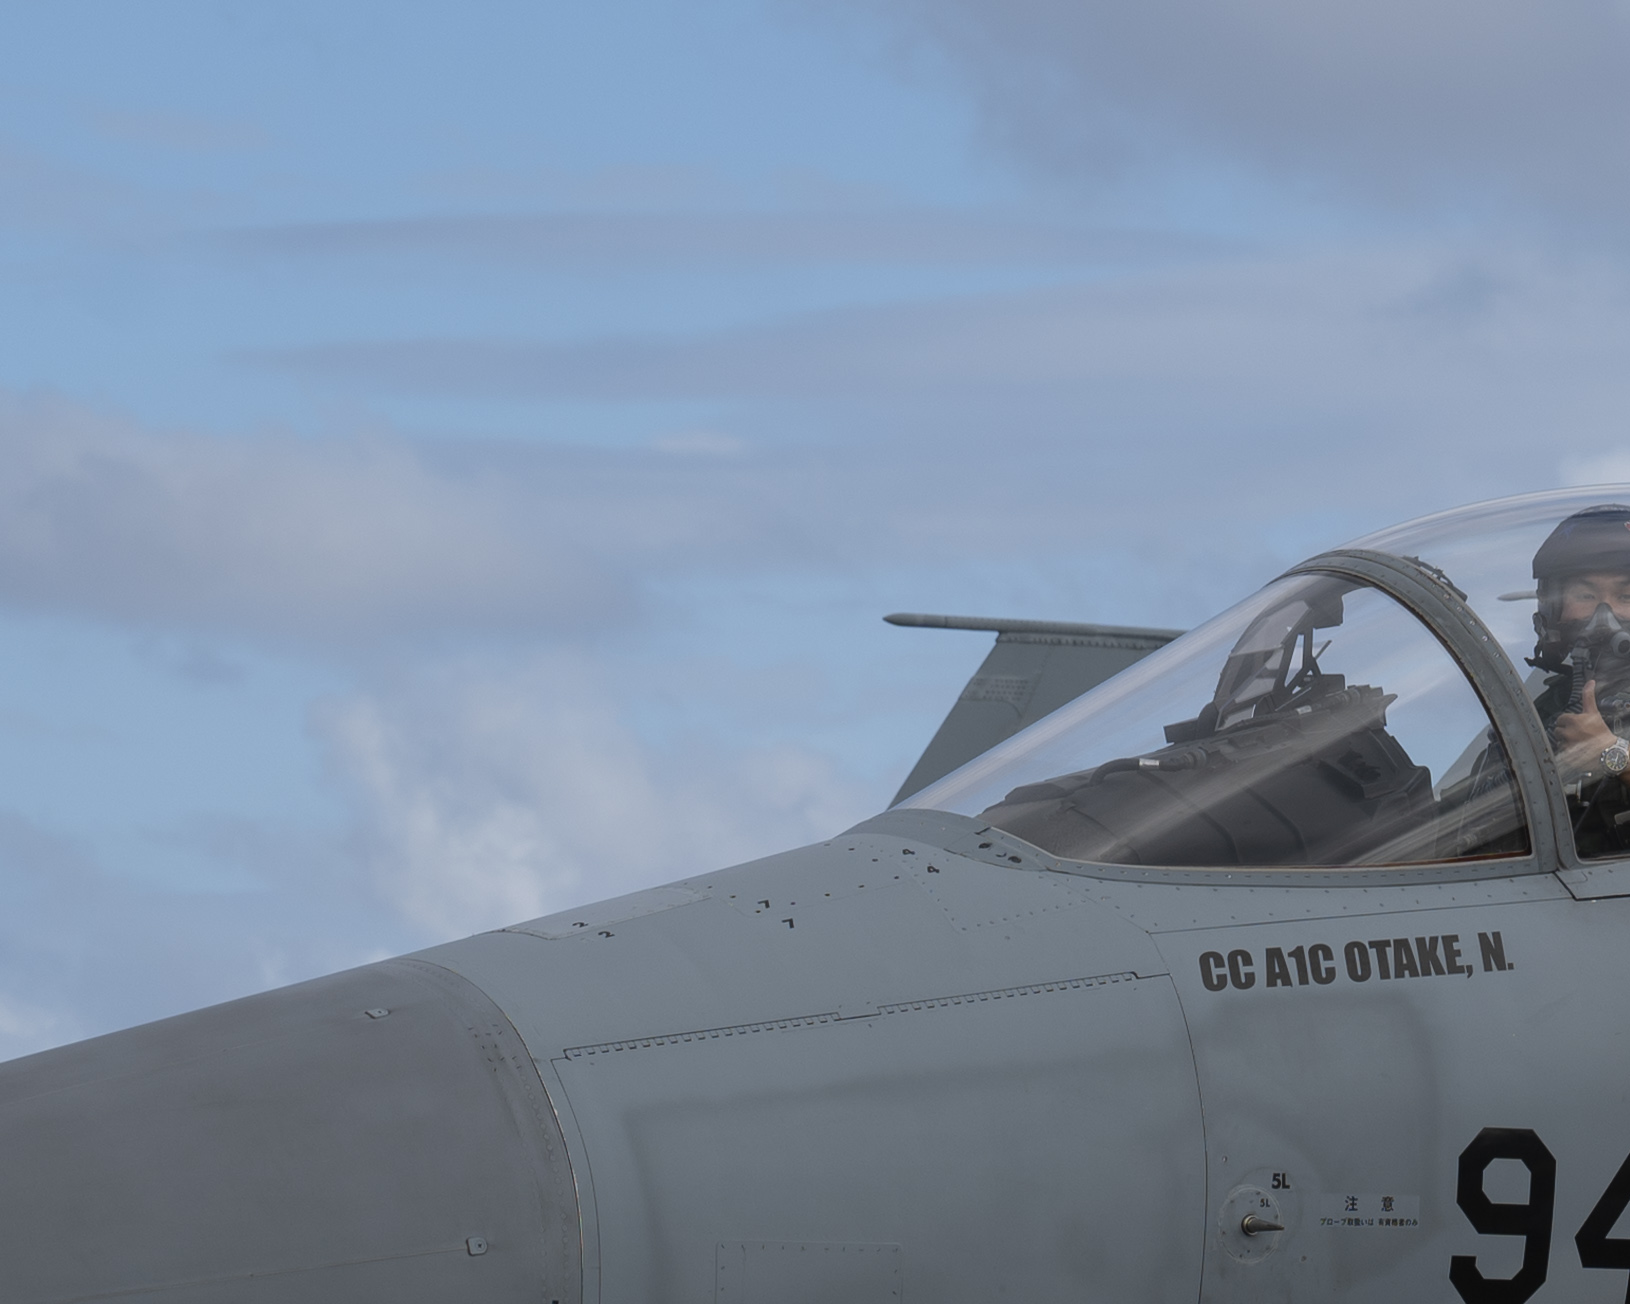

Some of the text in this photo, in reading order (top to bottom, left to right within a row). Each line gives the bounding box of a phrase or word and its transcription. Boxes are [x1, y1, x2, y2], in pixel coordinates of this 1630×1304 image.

[757, 899, 771, 909] 7
[781, 917, 795, 929] 7
[597, 930, 616, 939] 2
[1199, 931, 1515, 991] CC A1C OTAKE, N.
[1271, 1172, 1291, 1190] 5L
[1259, 1197, 1271, 1208] 5L
[1344, 1195, 1394, 1213] 注意
